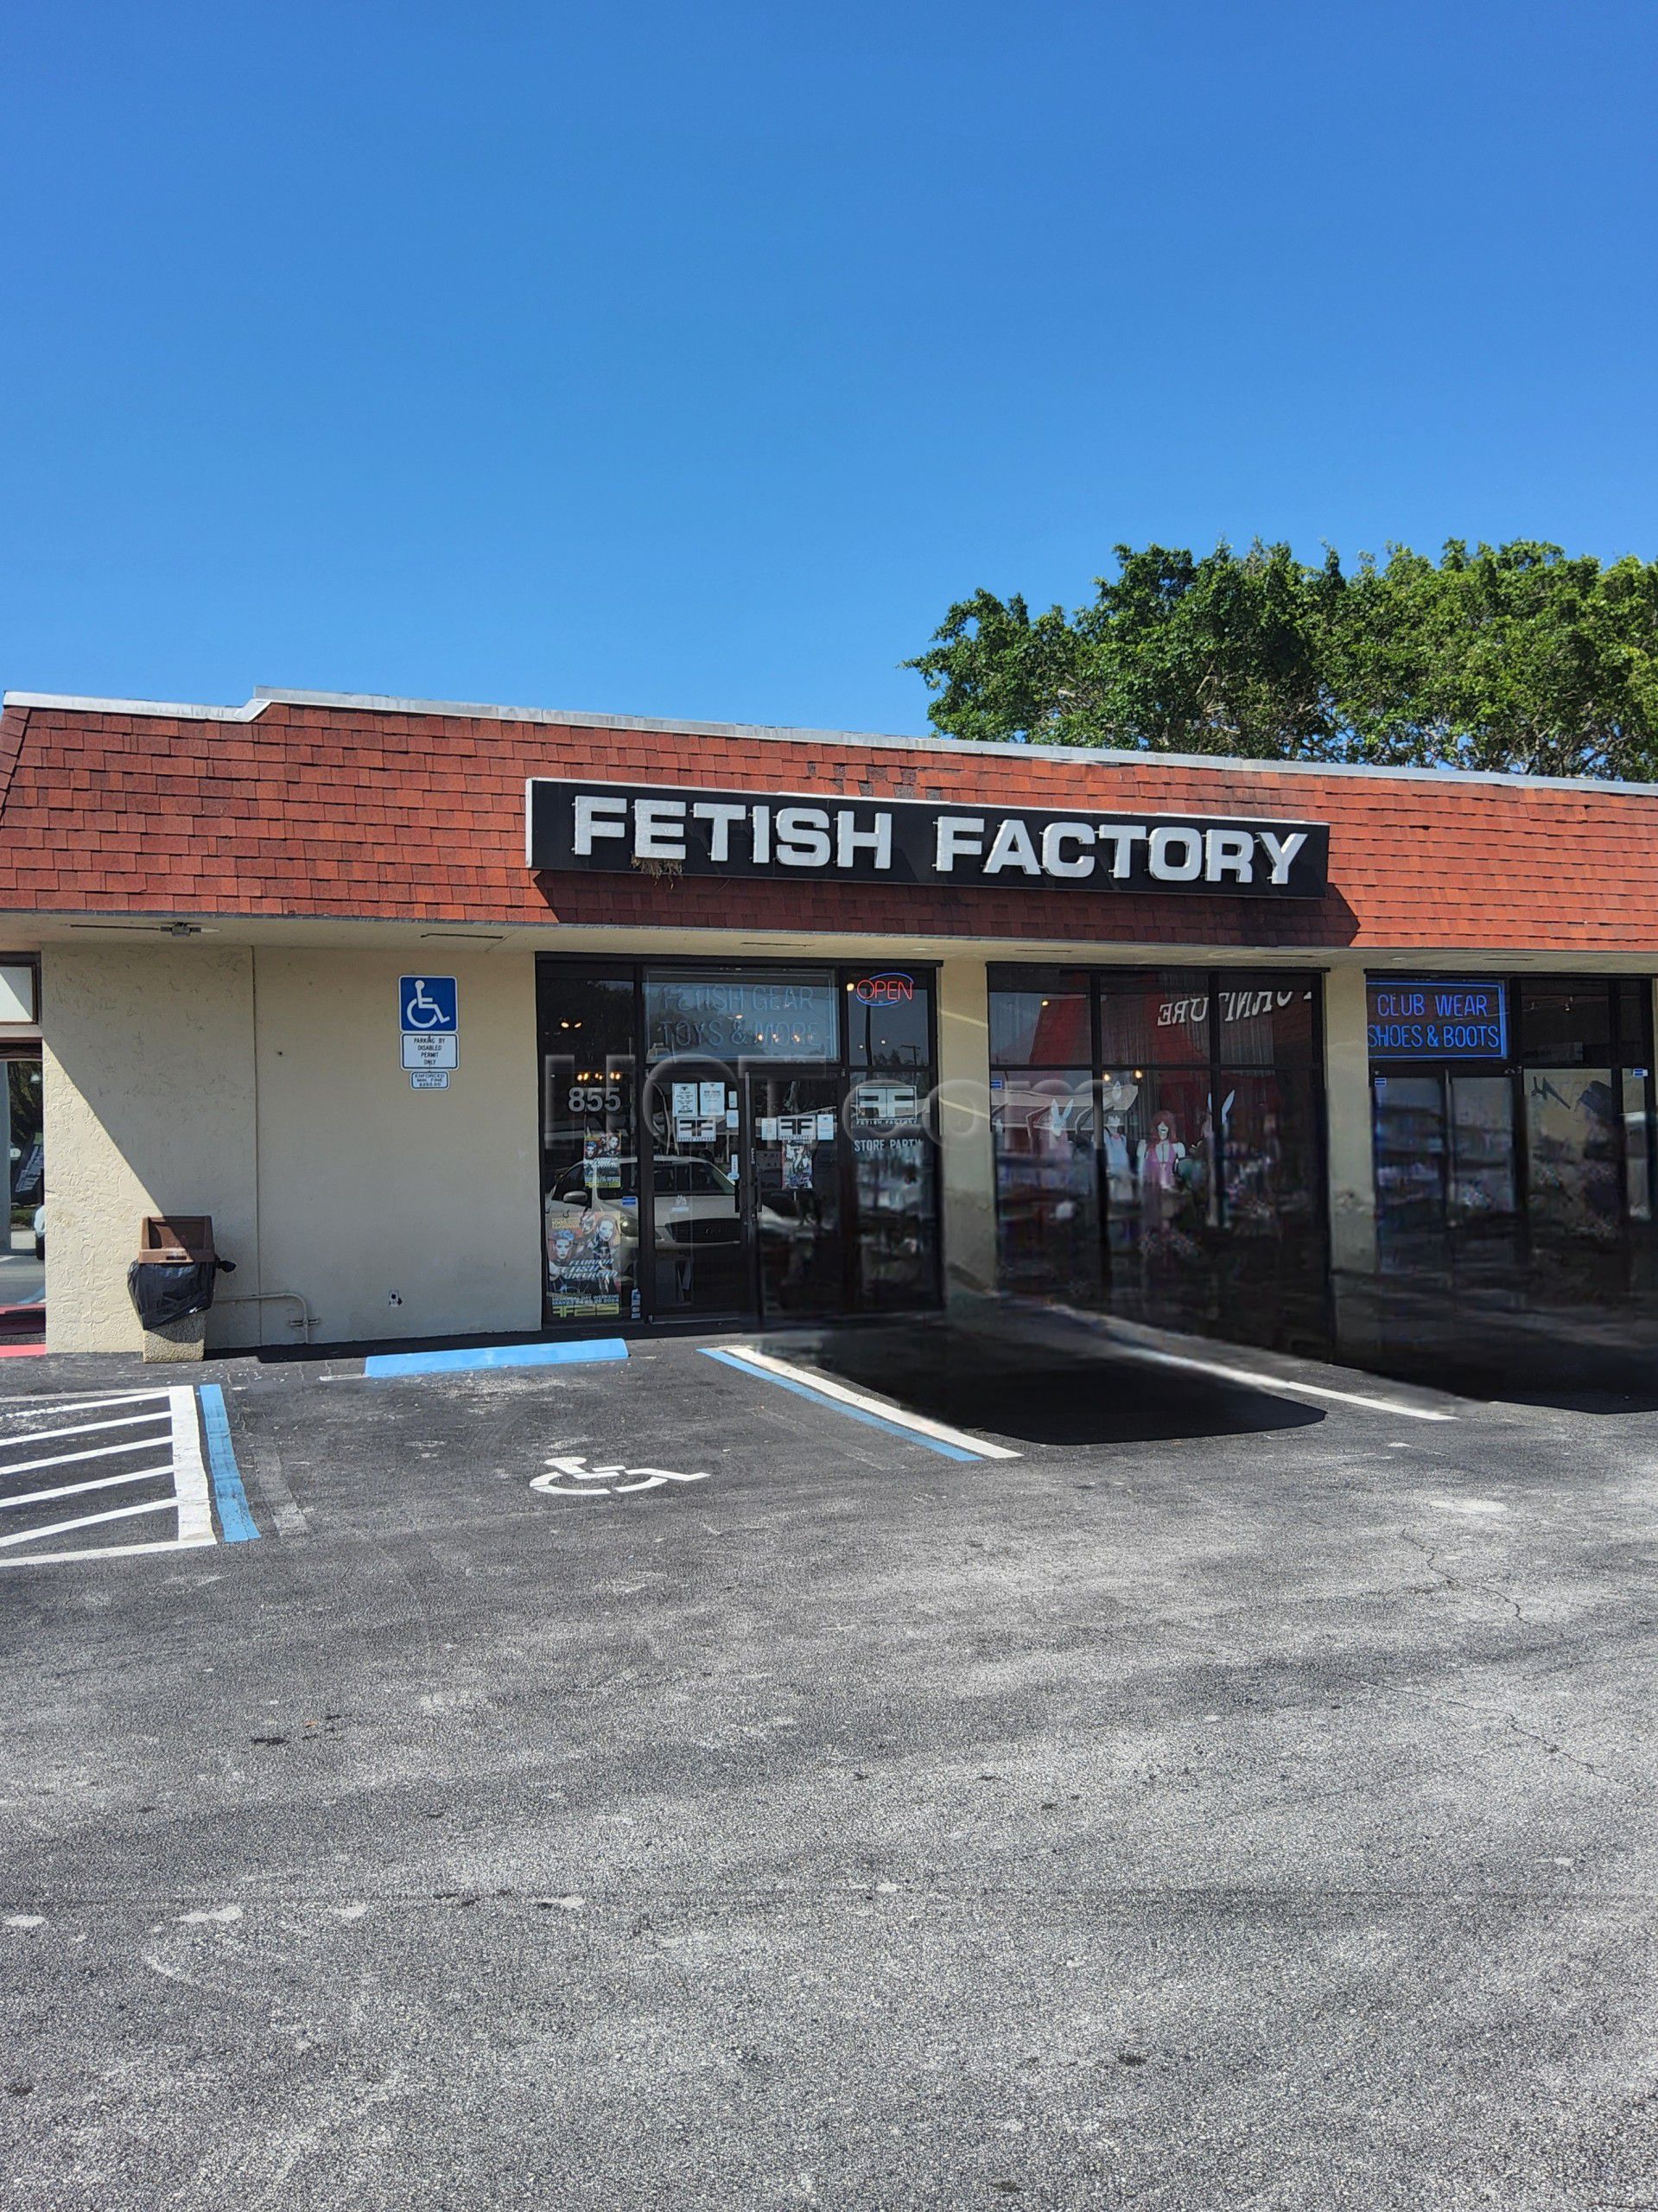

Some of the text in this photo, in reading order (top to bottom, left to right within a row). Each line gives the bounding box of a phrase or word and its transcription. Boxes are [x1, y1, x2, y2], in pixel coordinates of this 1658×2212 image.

[574, 795, 1308, 885] FETISH FACTORY
[664, 985, 814, 1011] FETISH GEAR
[856, 979, 913, 1001] OPEN
[1377, 994, 1488, 1017] CLUB WEAR
[660, 1019, 820, 1046] TOYS & MORE
[1368, 1024, 1500, 1048] SHOES & BOOTS
[569, 1086, 621, 1112] 855
[854, 1139, 886, 1152] STORE
